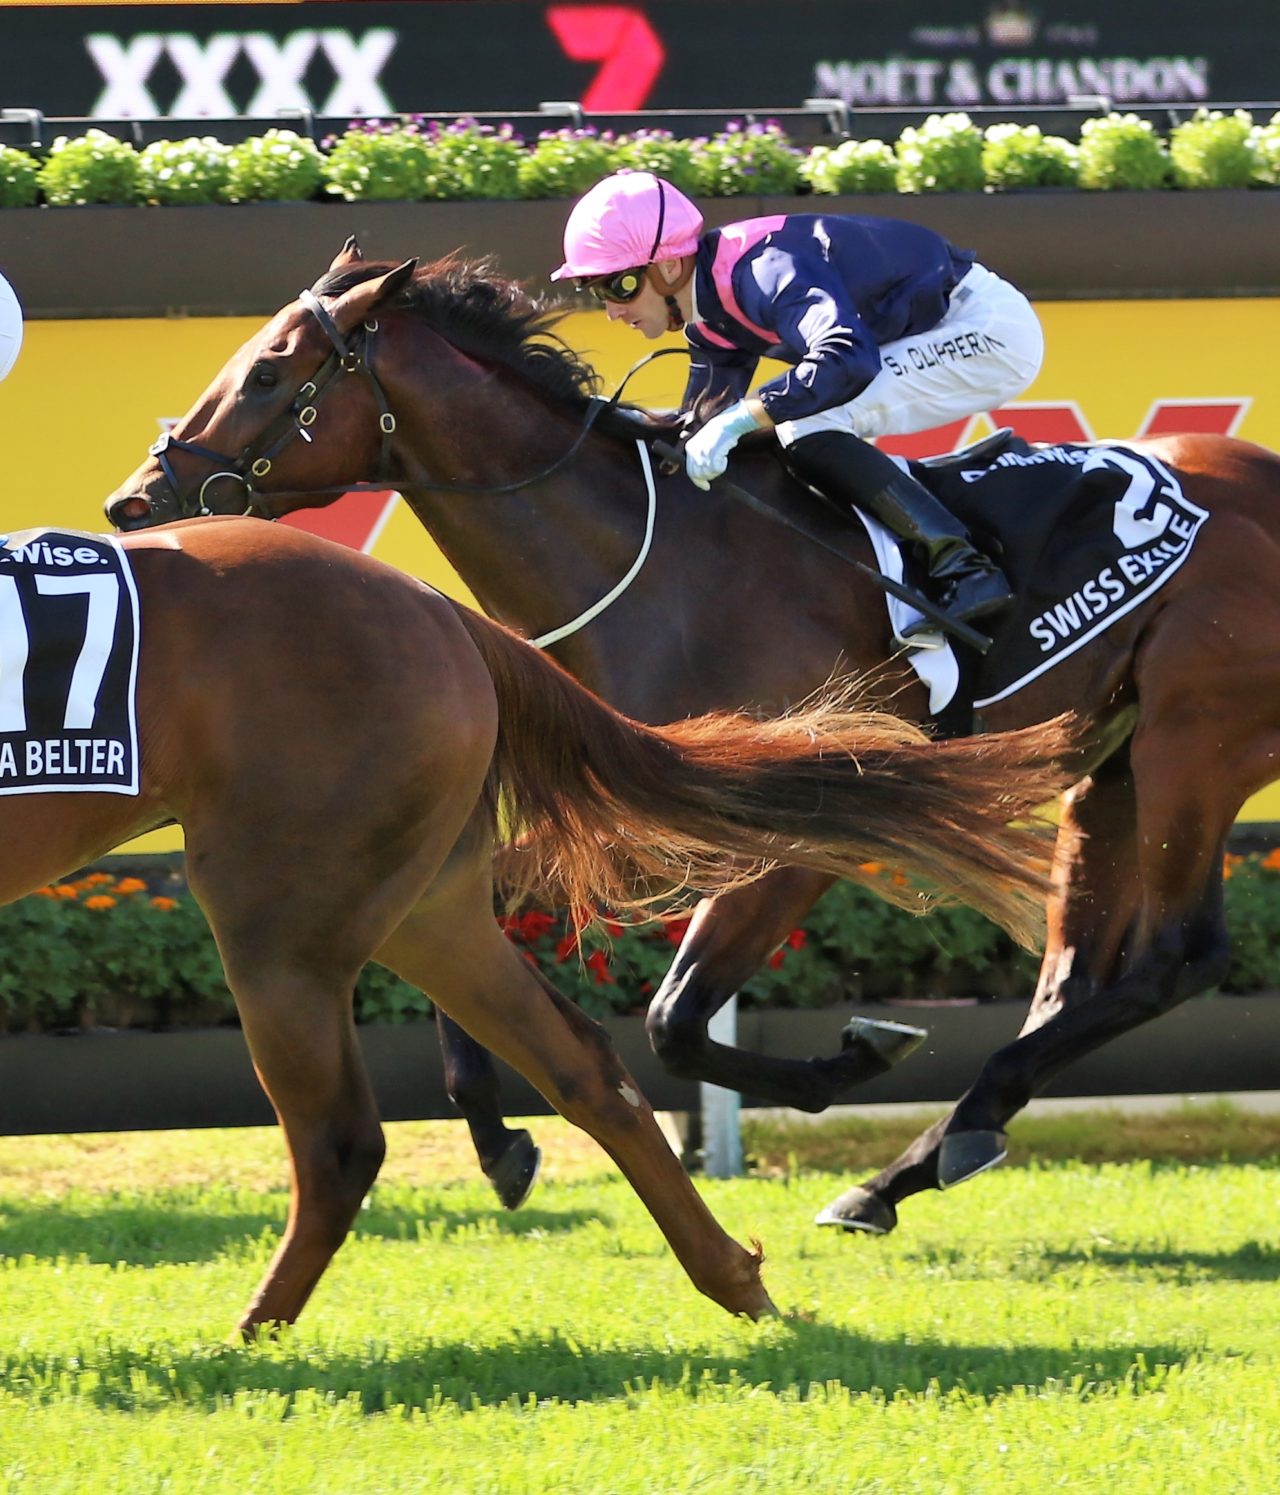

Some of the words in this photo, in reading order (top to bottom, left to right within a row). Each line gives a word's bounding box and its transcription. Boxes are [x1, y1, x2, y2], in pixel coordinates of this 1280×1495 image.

[84, 29, 399, 118] XXXX
[945, 58, 982, 104] &
[987, 56, 1209, 102] CHANDON
[1028, 568, 1126, 652] SWISS
[1117, 513, 1195, 587] EXILE
[25, 739, 125, 777] BELTER
